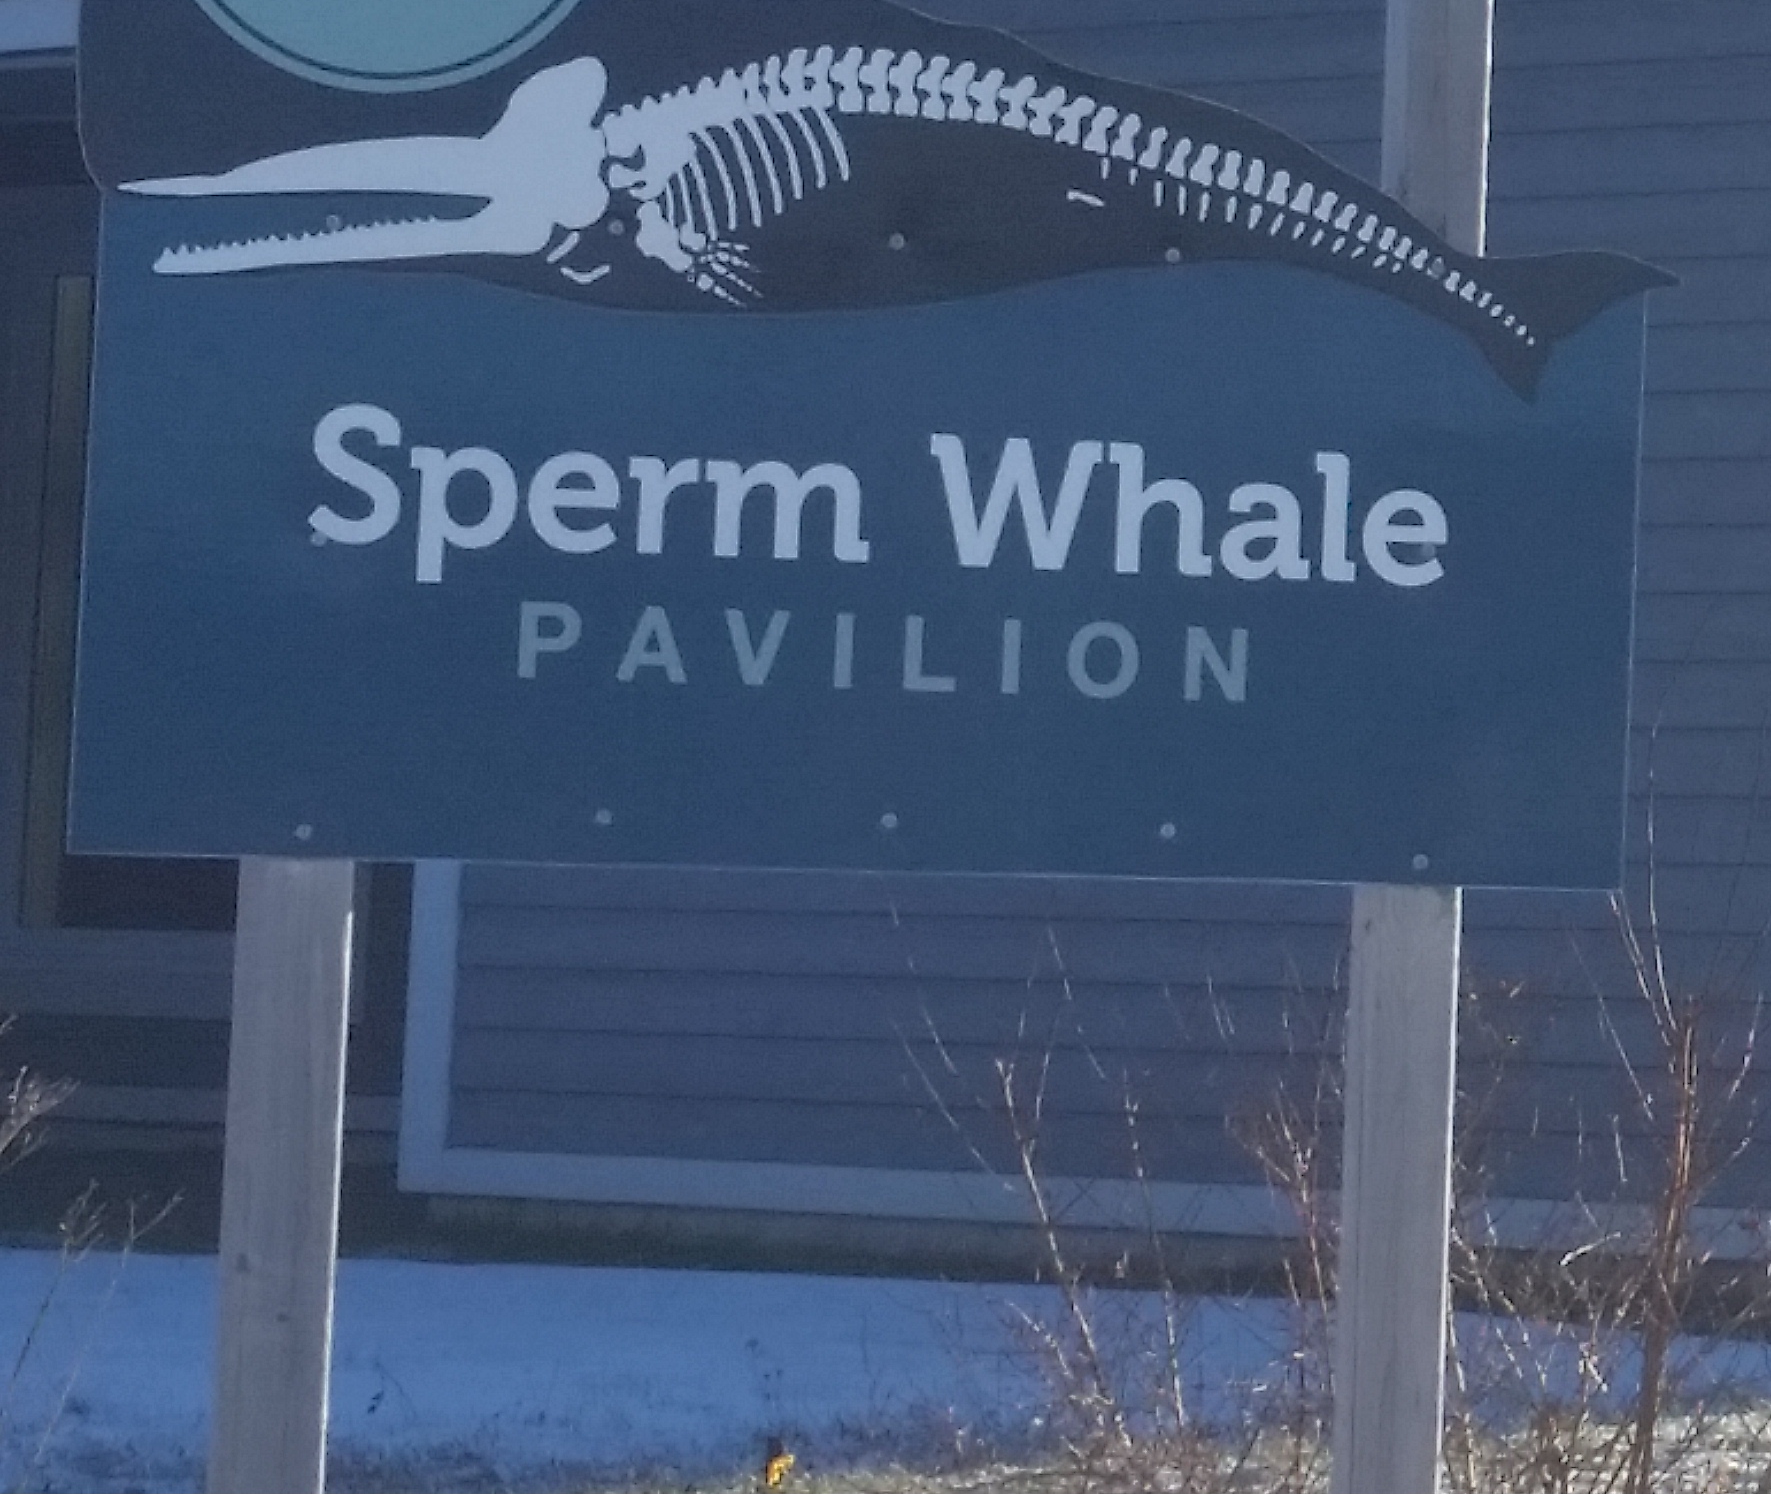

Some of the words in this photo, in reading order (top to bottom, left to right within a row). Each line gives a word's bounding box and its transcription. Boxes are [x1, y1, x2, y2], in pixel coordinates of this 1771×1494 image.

[308, 403, 869, 582] Sperm
[929, 433, 1449, 586] Whale
[515, 599, 1250, 702] PAVILION
